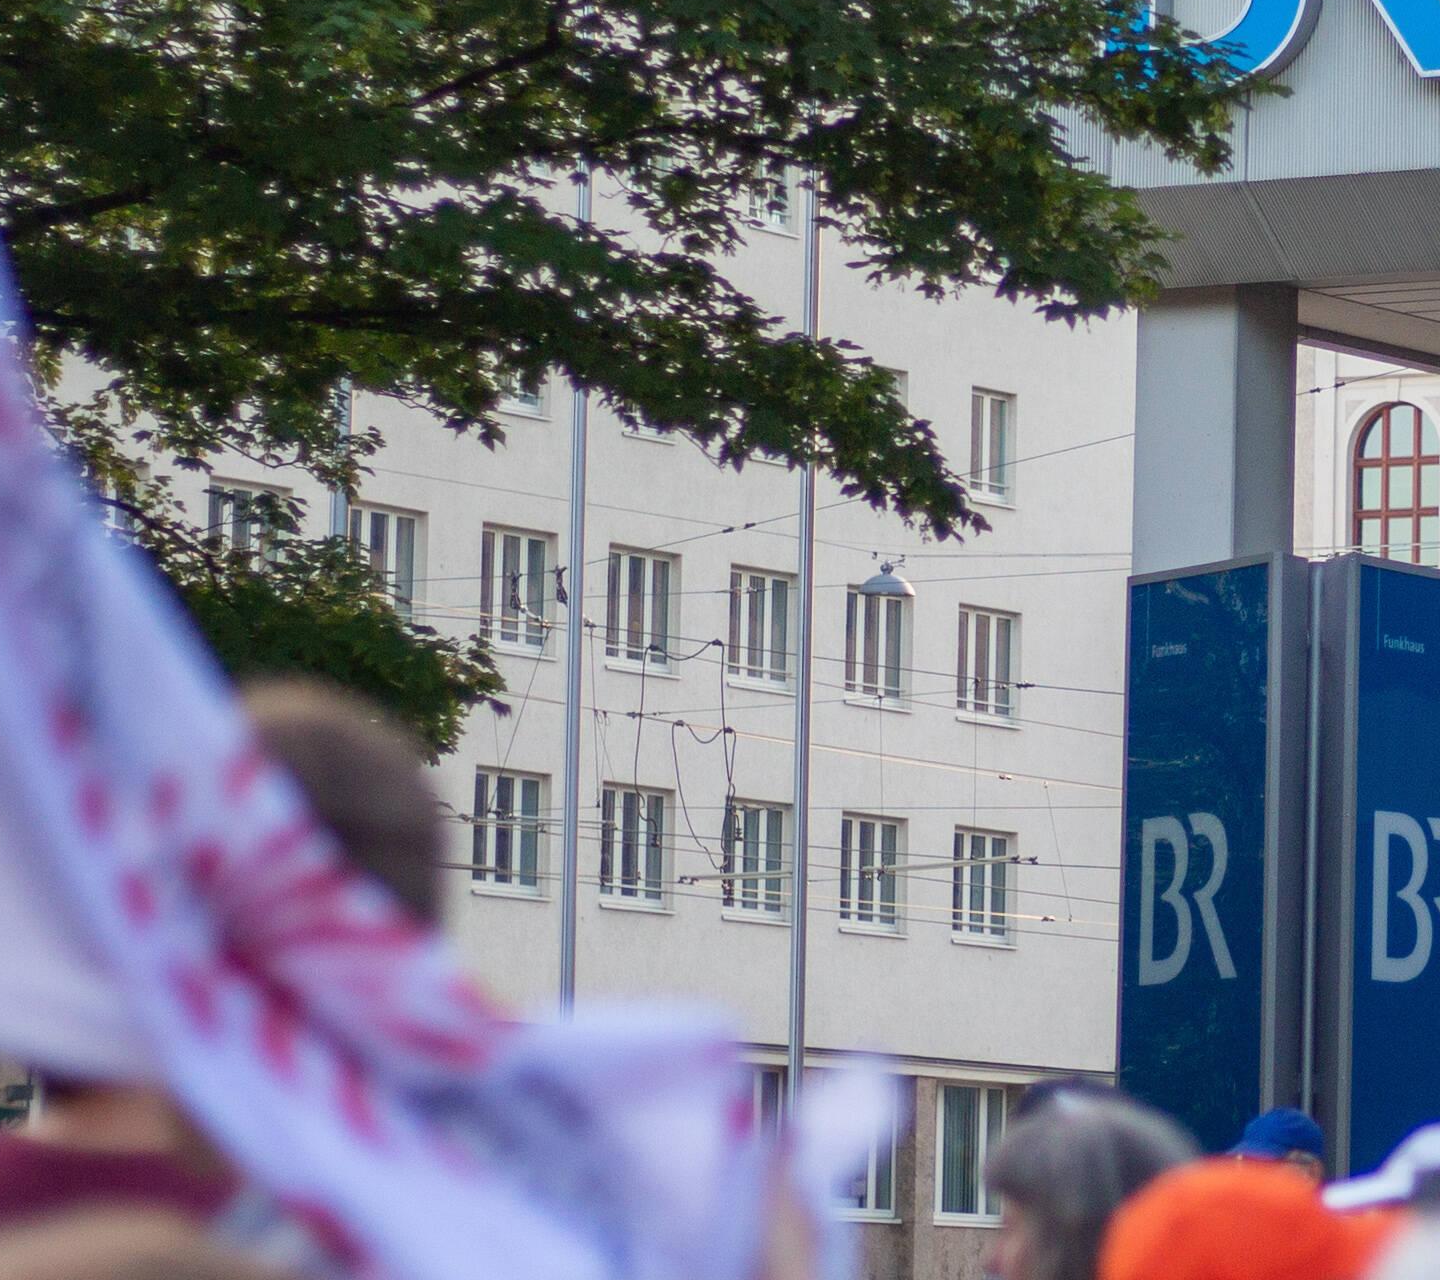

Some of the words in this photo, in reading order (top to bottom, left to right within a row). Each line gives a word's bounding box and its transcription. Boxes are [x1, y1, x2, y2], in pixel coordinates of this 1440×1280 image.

[1151, 642, 1188, 659] Funkhaus
[1383, 633, 1425, 654] Funkhaus
[1138, 811, 1238, 987] BR
